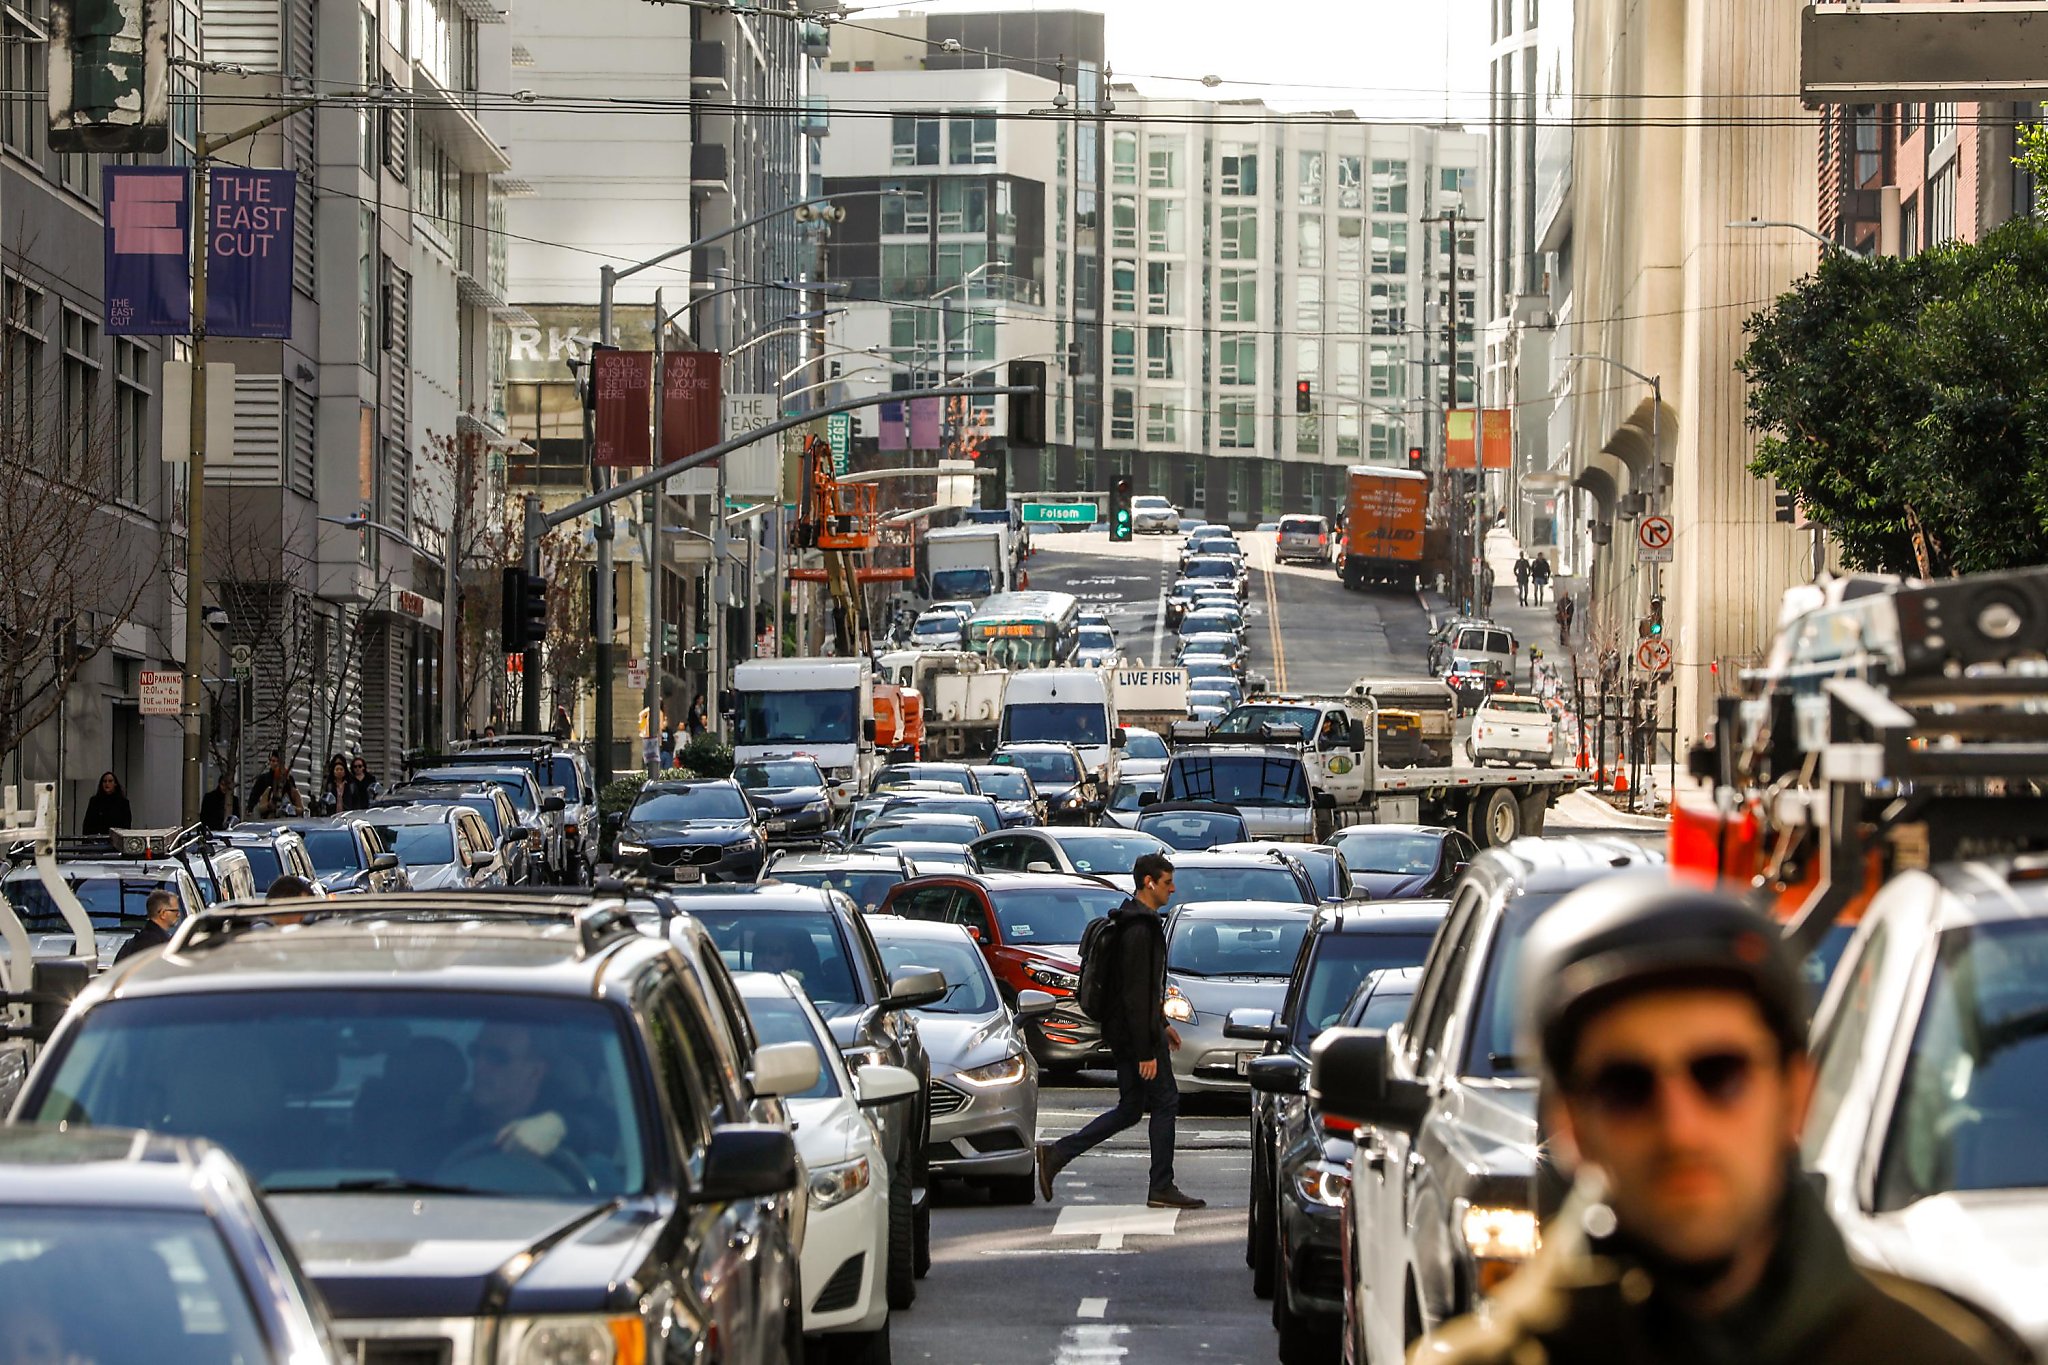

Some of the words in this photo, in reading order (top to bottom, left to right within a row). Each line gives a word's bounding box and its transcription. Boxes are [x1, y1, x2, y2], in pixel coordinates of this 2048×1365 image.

[216, 177, 272, 202] THE
[216, 205, 287, 231] EAST
[215, 233, 274, 257] CUT
[111, 299, 129, 308] THE
[111, 308, 135, 317] EAST
[110, 317, 131, 326] CUT
[605, 357, 634, 367] GOLD
[674, 357, 697, 367] AND
[598, 368, 643, 378] RUSHERS
[667, 368, 696, 378] NOW
[605, 379, 647, 389] SETTLED
[674, 379, 710, 388] YOU'RE
[731, 400, 763, 415] THE
[831, 420, 847, 469] COLLEGE
[1040, 508, 1079, 518] Folsom
[141, 672, 154, 684] NO
[155, 675, 181, 684] PARKING
[1120, 672, 1147, 685] LIVE
[1152, 672, 1181, 685] FISH
[143, 697, 155, 705] TUE
